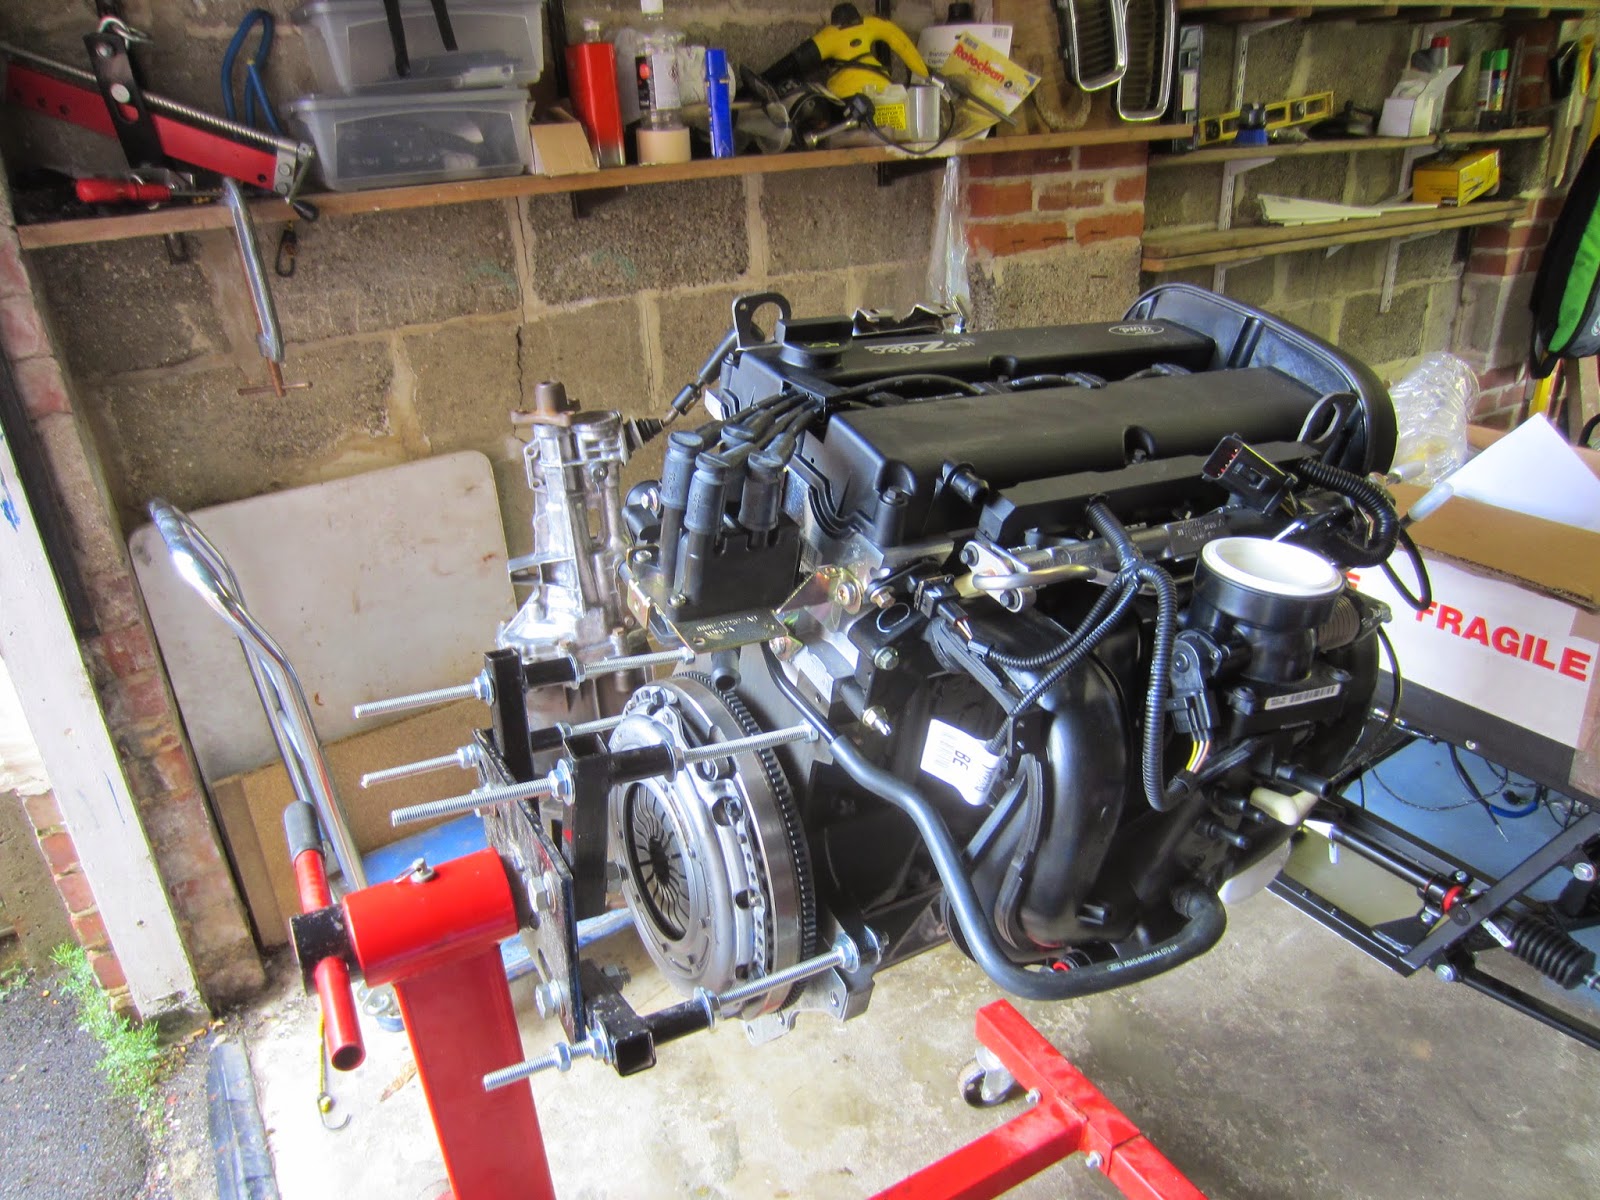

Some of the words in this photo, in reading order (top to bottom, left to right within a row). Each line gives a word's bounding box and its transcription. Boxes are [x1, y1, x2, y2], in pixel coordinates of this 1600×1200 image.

[954, 44, 1005, 83] Rotoclean
[1415, 597, 1591, 682] FRAGILE
[953, 750, 971, 770] BE
